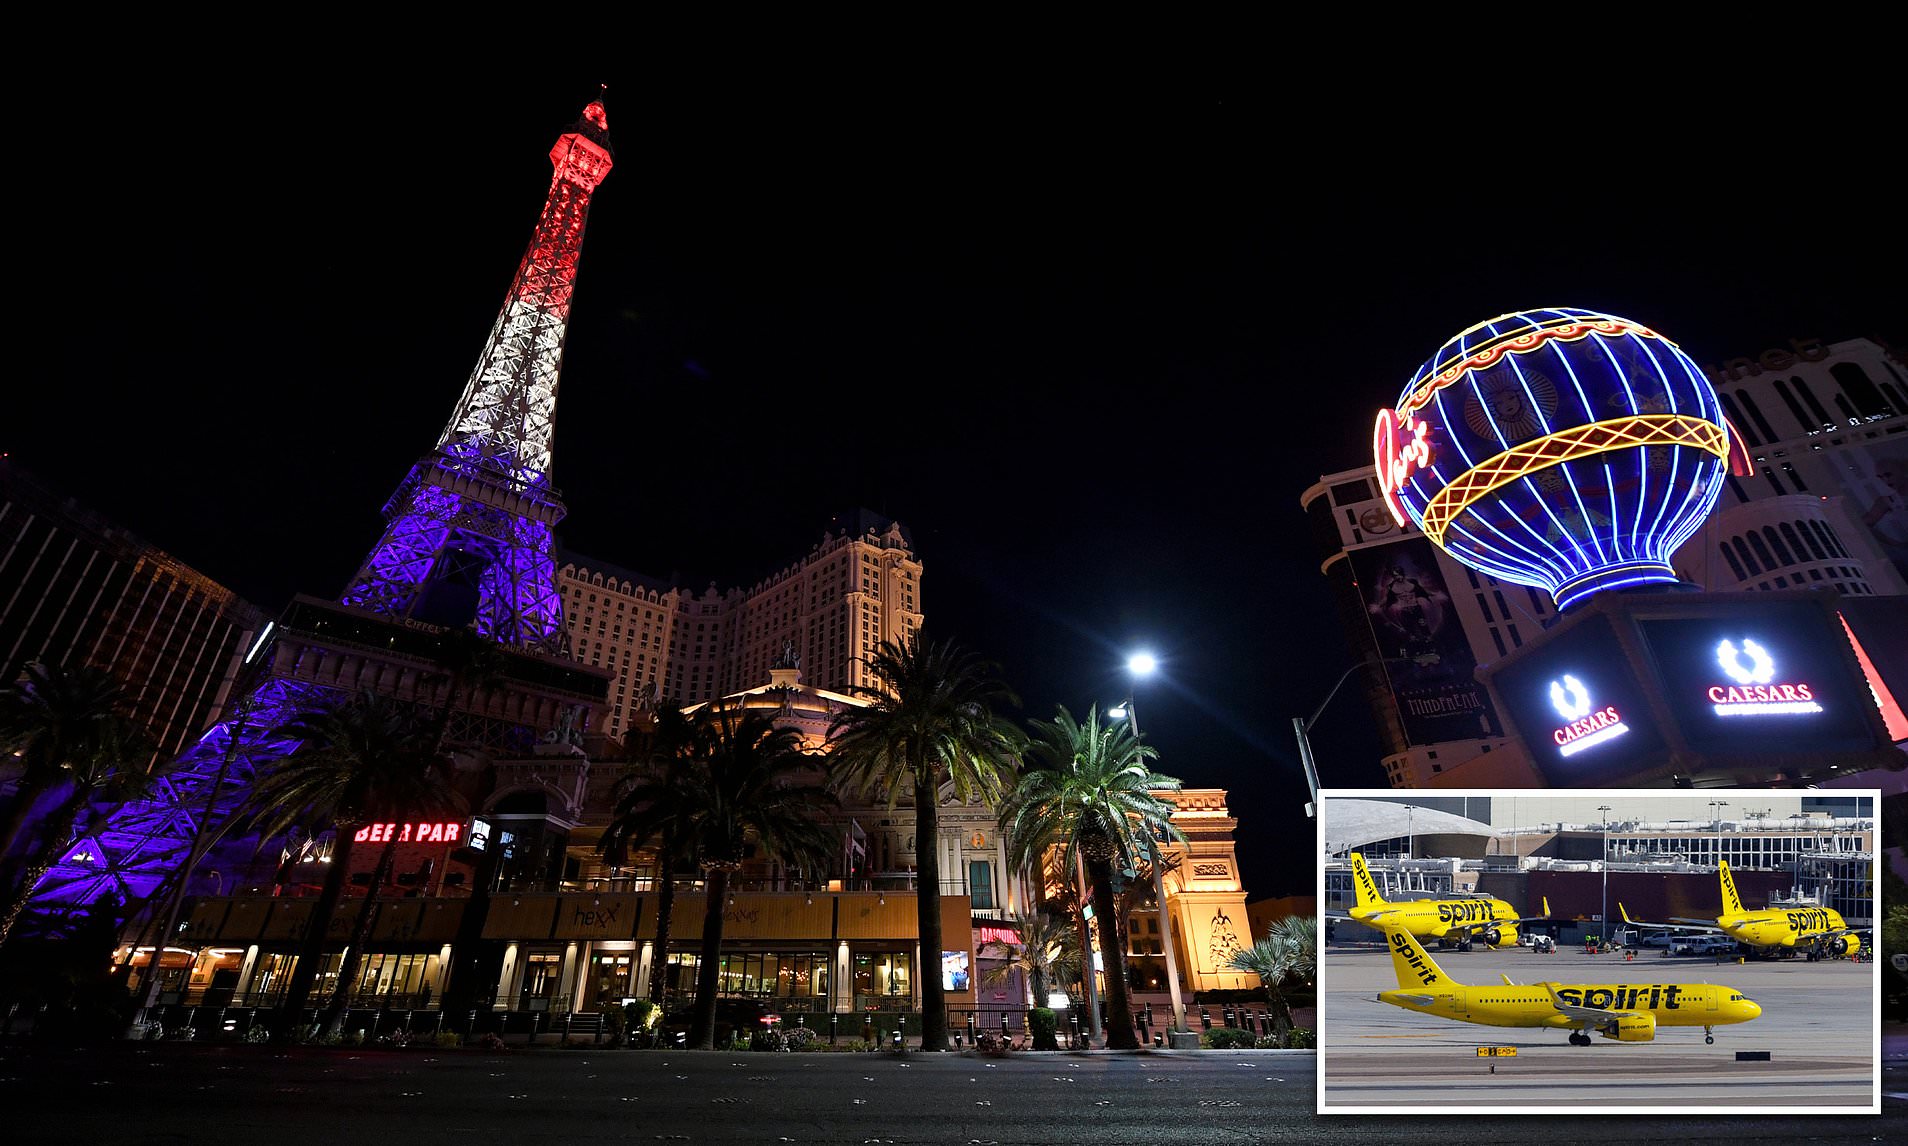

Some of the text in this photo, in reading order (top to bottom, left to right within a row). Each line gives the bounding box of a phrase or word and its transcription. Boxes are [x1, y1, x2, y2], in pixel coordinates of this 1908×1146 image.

[1708, 683, 1814, 704] CAESARS
[1553, 706, 1620, 746] CAESARS
[415, 823, 468, 842] PAR
[1354, 859, 1376, 903] spirit
[1722, 867, 1739, 912] spirit
[574, 903, 620, 929] hexx
[1437, 900, 1495, 928] spirit
[1786, 908, 1831, 937] spirit
[1391, 933, 1437, 986] spirit
[1556, 985, 1682, 1010] spirit
